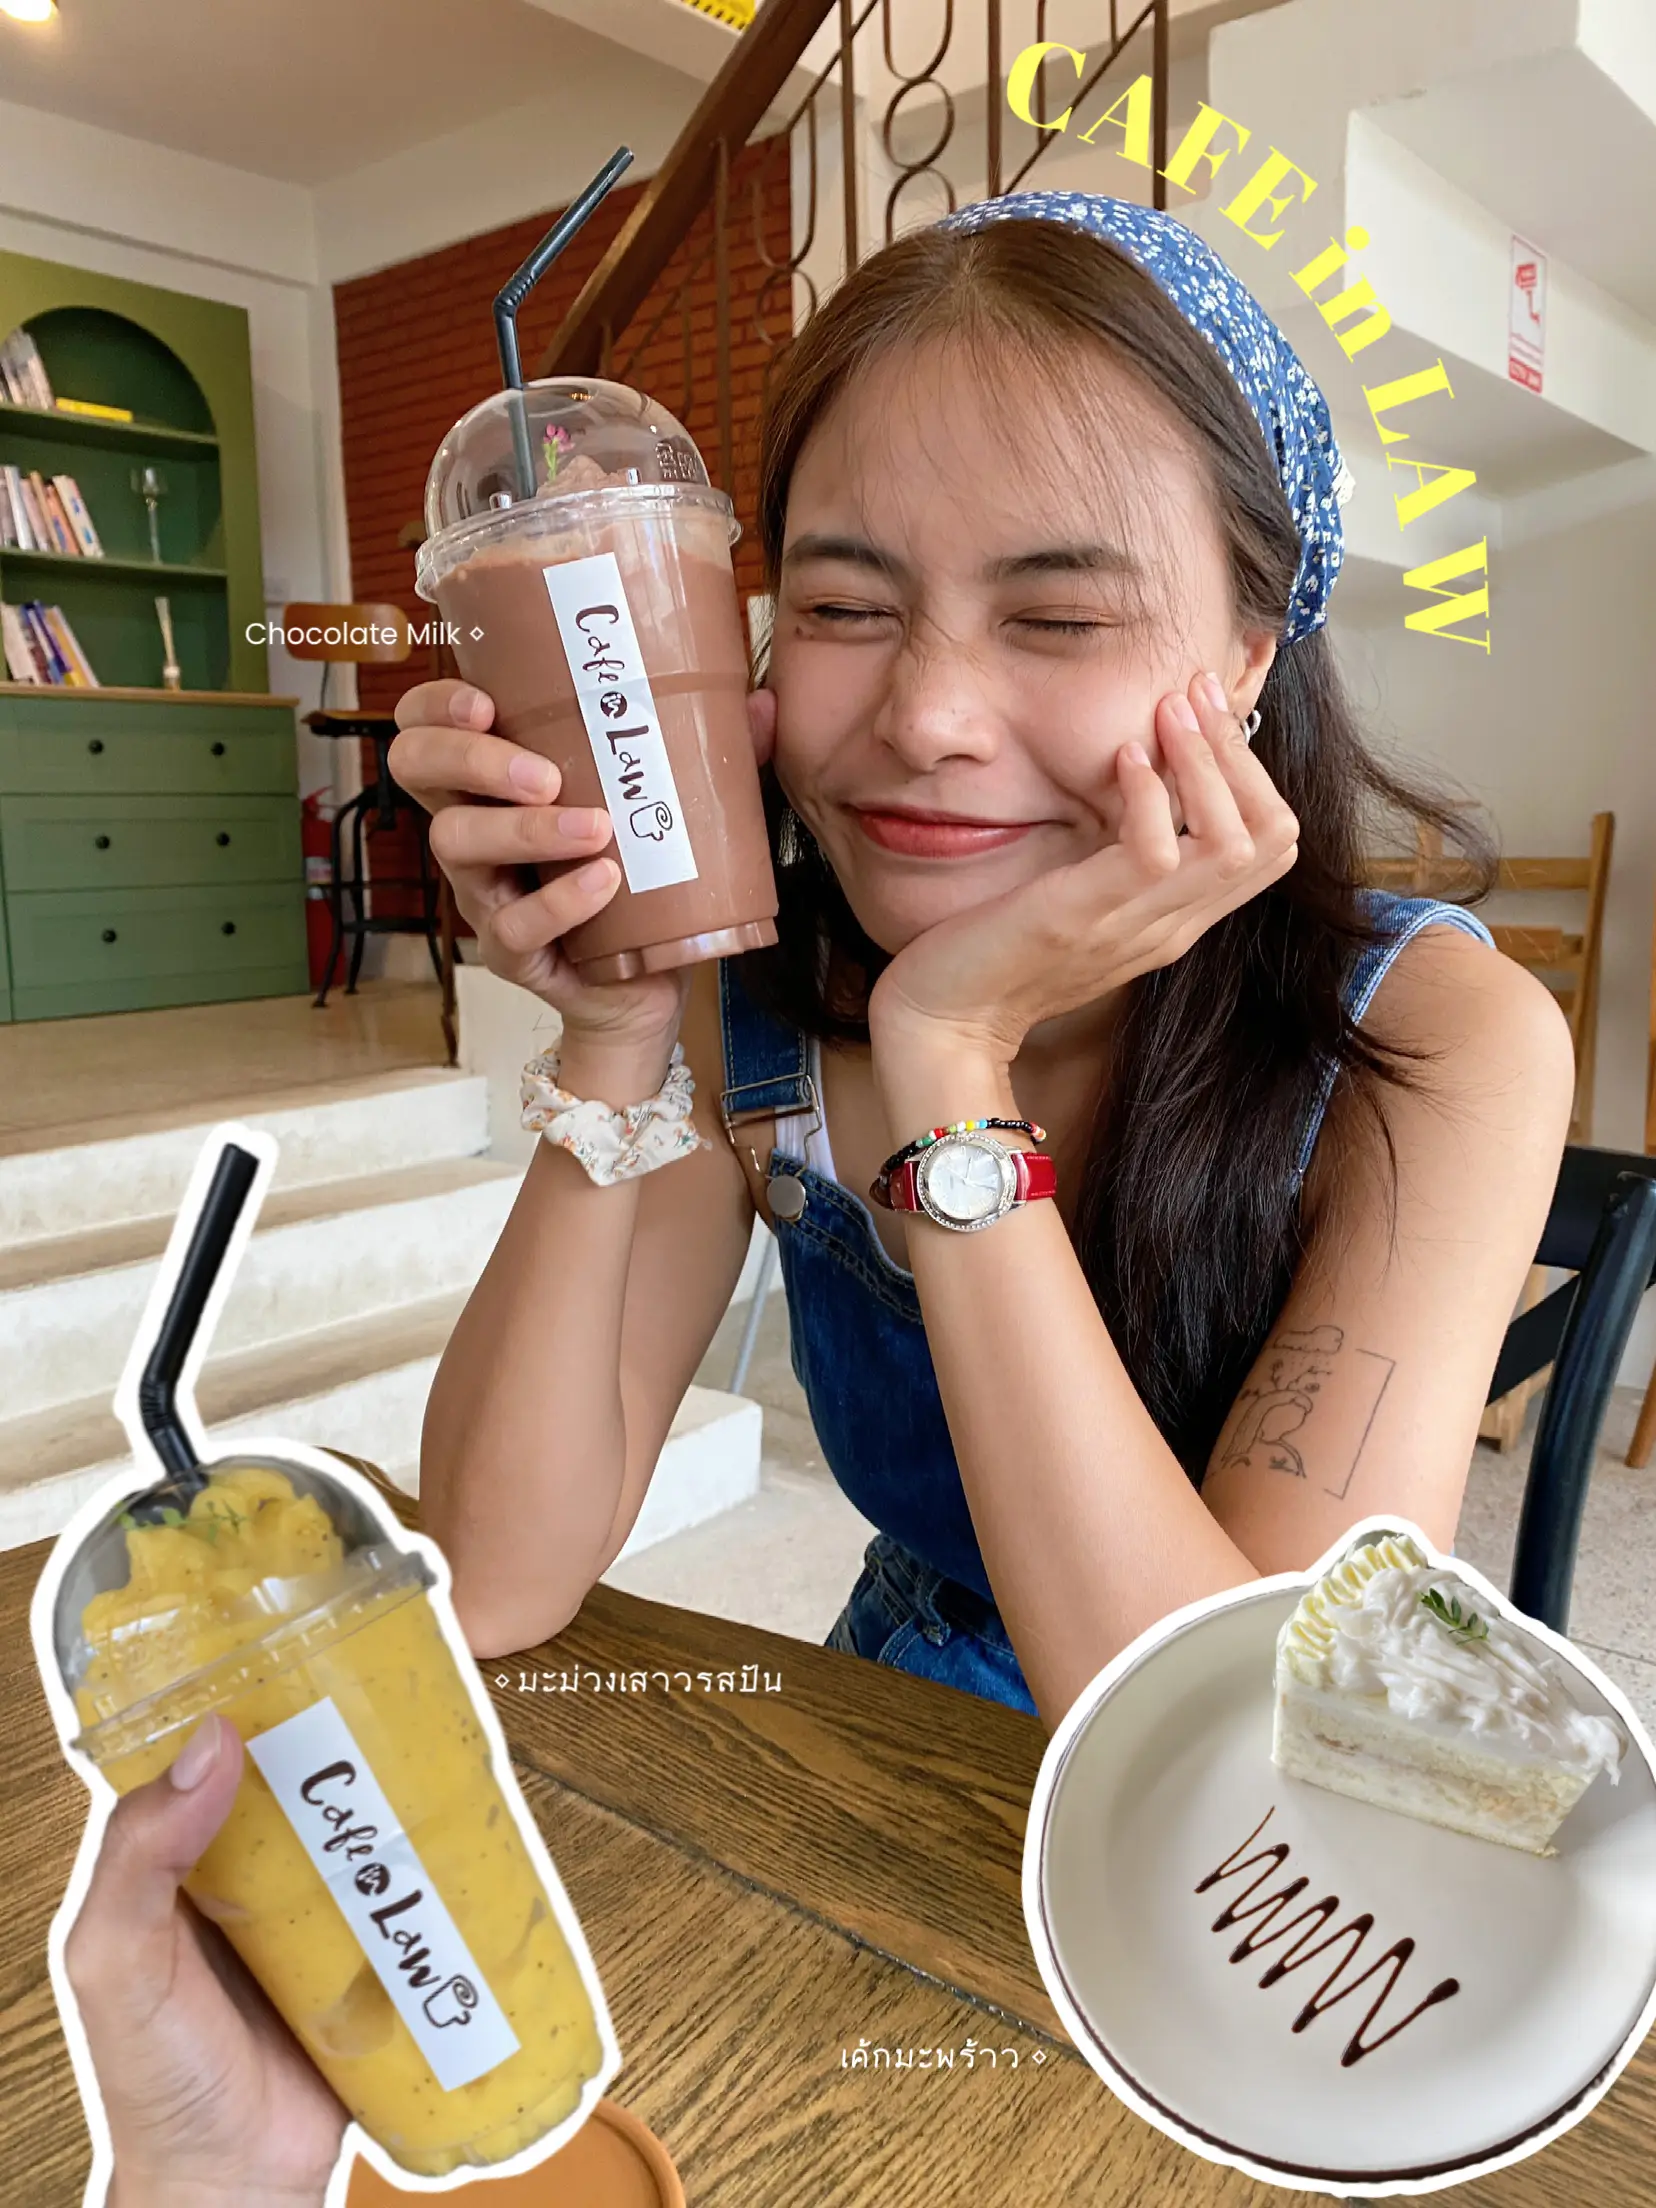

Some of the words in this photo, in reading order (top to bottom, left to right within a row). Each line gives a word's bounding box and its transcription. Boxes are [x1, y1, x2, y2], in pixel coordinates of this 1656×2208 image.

[575, 604, 626, 682] Cafe
[600, 692, 627, 719] in
[606, 725, 650, 800] Law
[300, 1760, 378, 1861] Cafe
[357, 1864, 390, 1894] in
[369, 1889, 440, 1988] Law
